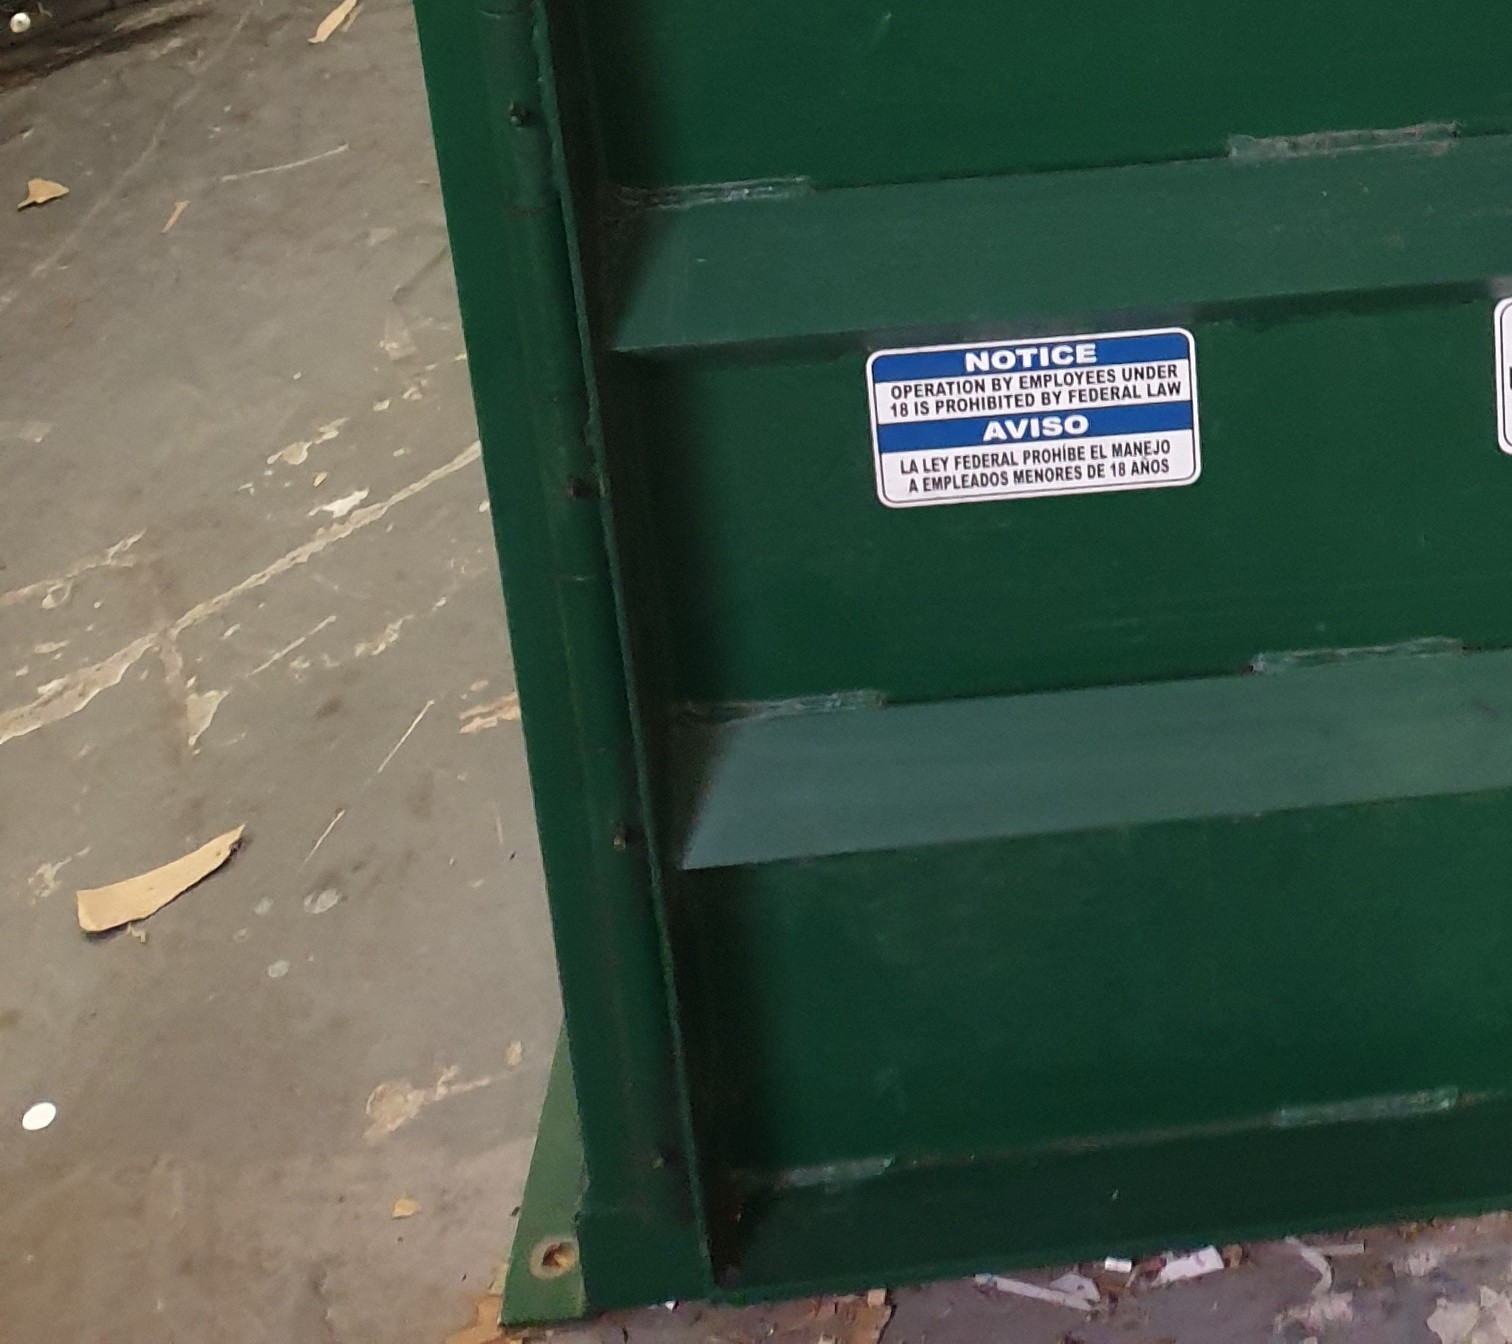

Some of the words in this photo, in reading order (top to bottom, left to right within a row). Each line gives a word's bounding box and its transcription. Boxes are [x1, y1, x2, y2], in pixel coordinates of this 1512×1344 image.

[965, 343, 1097, 373] NOTICE
[890, 402, 908, 418] 18
[914, 400, 929, 415] IS
[936, 392, 1034, 414] PROHIBITED
[1042, 390, 1062, 406] BY
[1068, 383, 1141, 403] FEDERAL
[1147, 381, 1181, 397] LAW
[891, 376, 985, 400] OPERATION
[992, 376, 1012, 392] BY
[1019, 367, 1115, 389] EMPLOYEES
[1123, 363, 1178, 381] UNDER
[982, 414, 1089, 442] AVISO
[901, 456, 919, 474] LA
[923, 455, 948, 472] LEY
[954, 448, 1019, 470] FEDERAL
[1023, 443, 1085, 467] PROHÍBE
[1091, 444, 1107, 459] EL
[1112, 439, 1171, 457] MANEJO
[909, 477, 918, 492] A
[923, 471, 1008, 491] EMPLEADOS
[1014, 465, 1082, 484] MENORES
[1087, 463, 1104, 479] DE
[1110, 462, 1126, 478] 18
[1131, 455, 1169, 474] AÑOS
